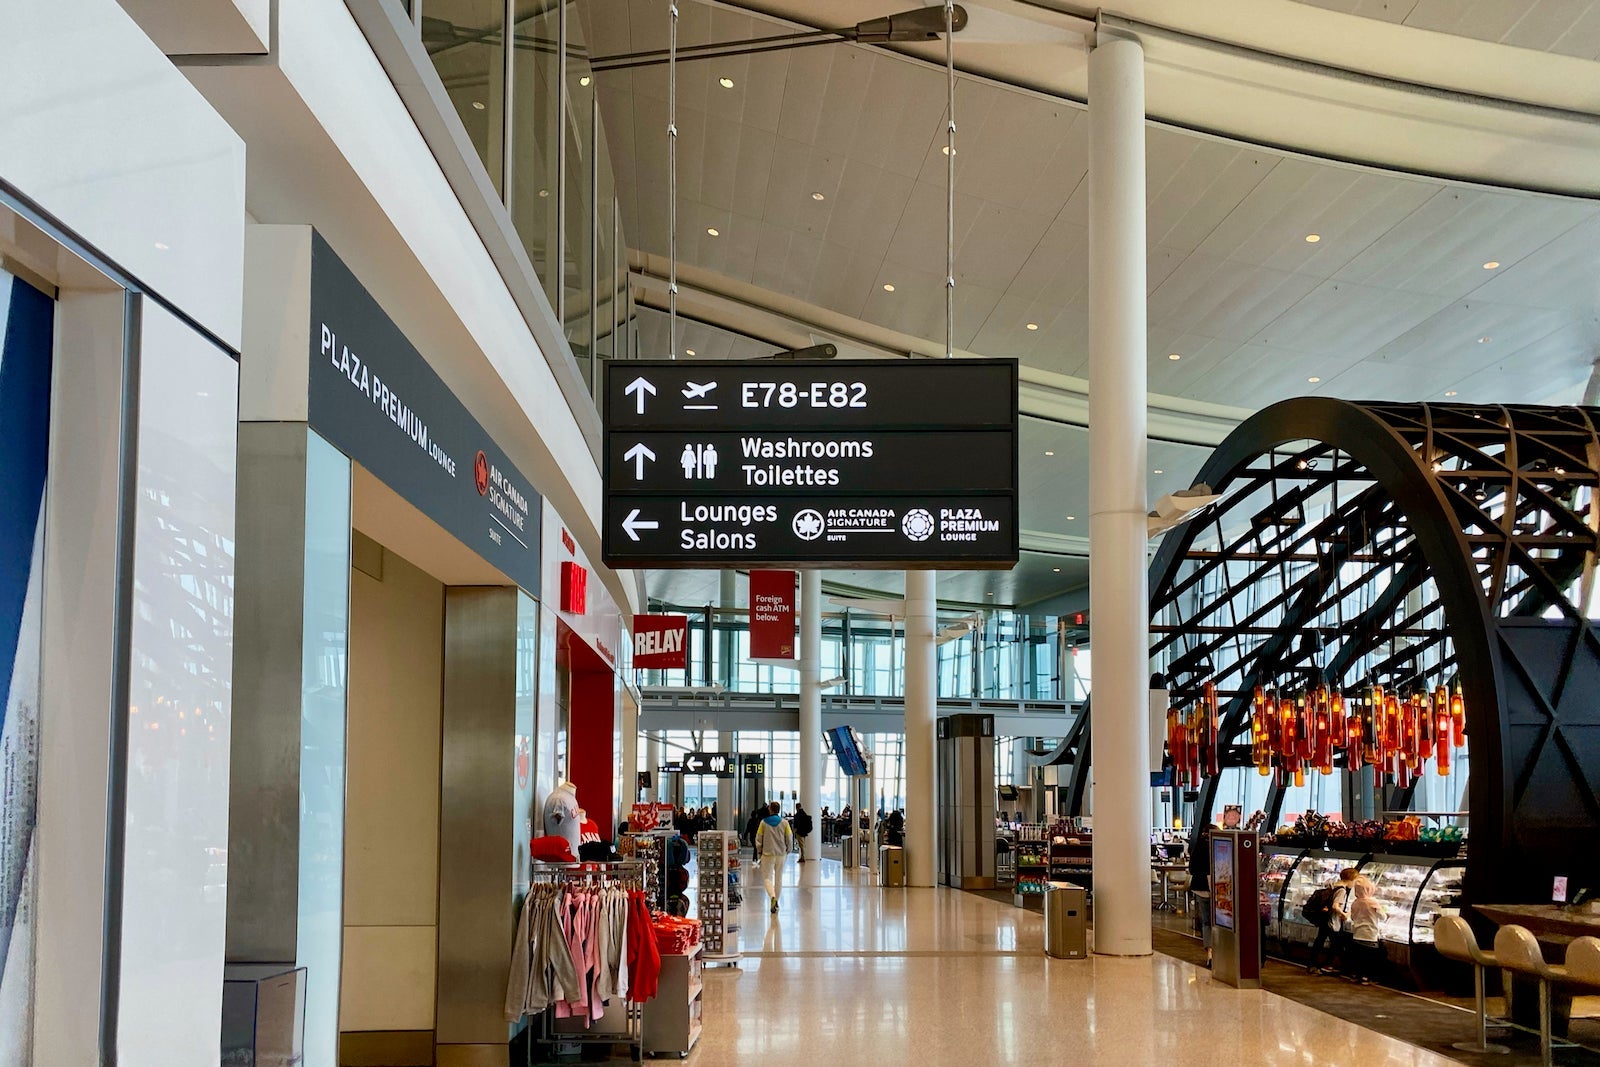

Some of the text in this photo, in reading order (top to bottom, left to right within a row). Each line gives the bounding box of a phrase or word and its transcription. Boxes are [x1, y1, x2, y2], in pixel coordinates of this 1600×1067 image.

[321, 322, 456, 478] PLAZA PREMIUM LOUNGE
[742, 382, 868, 408] E78-E82
[741, 437, 874, 459] Washrooms
[742, 464, 840, 486] Toilettes
[490, 465, 528, 516] AIR CANADA
[489, 486, 524, 532] SIGNATURE
[681, 501, 778, 528] Lounges
[827, 509, 896, 518] AIR CANADA
[940, 508, 983, 520] PLAZA
[827, 518, 887, 527] SIGNATURE
[940, 520, 1000, 532] PREMIUM
[488, 527, 502, 546] SUITE
[681, 528, 757, 550] Salons
[826, 534, 847, 542] SUITE
[940, 532, 977, 542] LOUNGE
[755, 594, 783, 605] Foreign
[755, 604, 790, 613] cash ATM
[755, 612, 779, 622] below.
[634, 628, 685, 656] RELAY
[745, 763, 764, 775] E79
